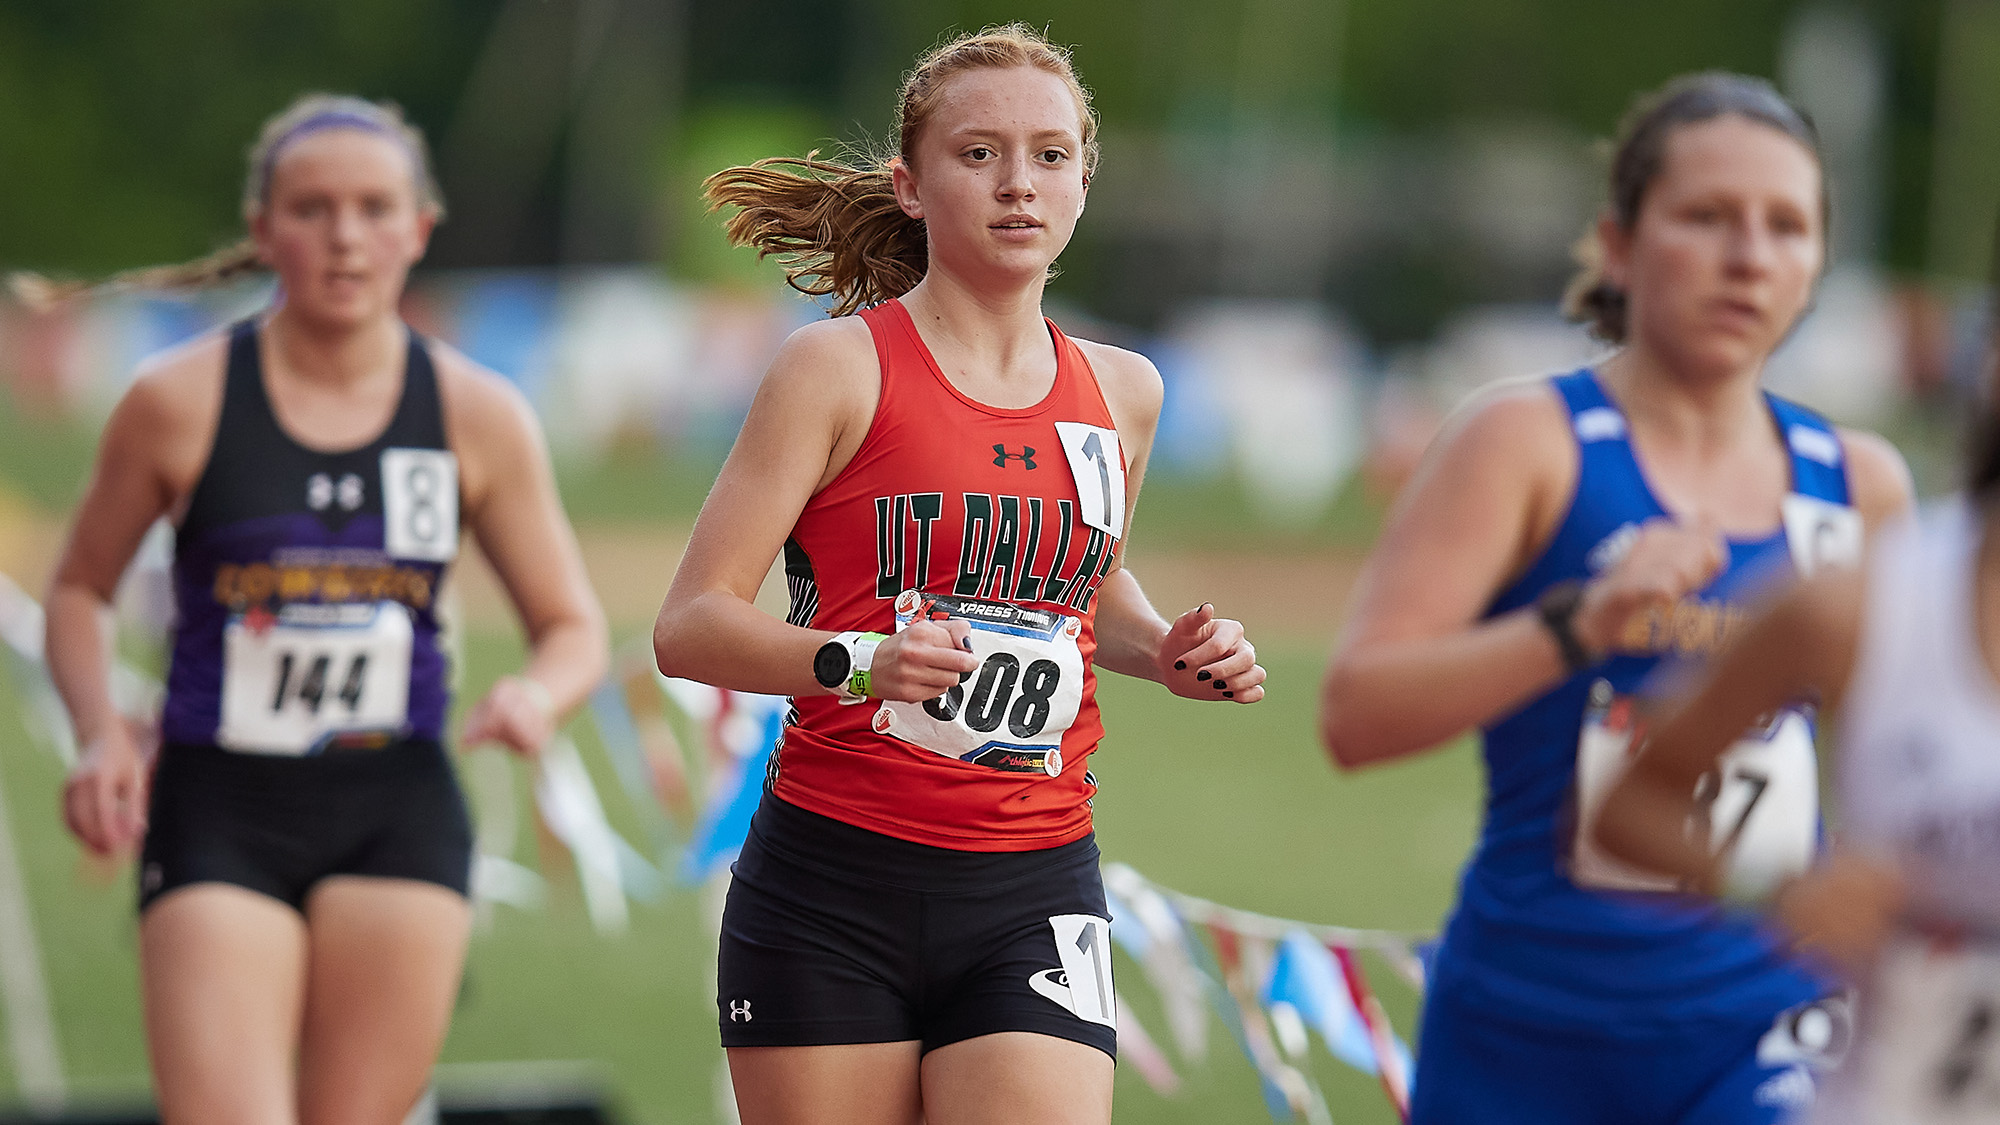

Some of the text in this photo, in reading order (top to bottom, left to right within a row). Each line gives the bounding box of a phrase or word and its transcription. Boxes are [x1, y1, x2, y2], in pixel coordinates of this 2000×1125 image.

[406, 464, 439, 542] 8
[1081, 432, 1112, 528] 1
[875, 492, 943, 599] UT
[957, 602, 1014, 618] XPRESS
[271, 653, 368, 713] 144
[1075, 921, 1109, 1019] 1
